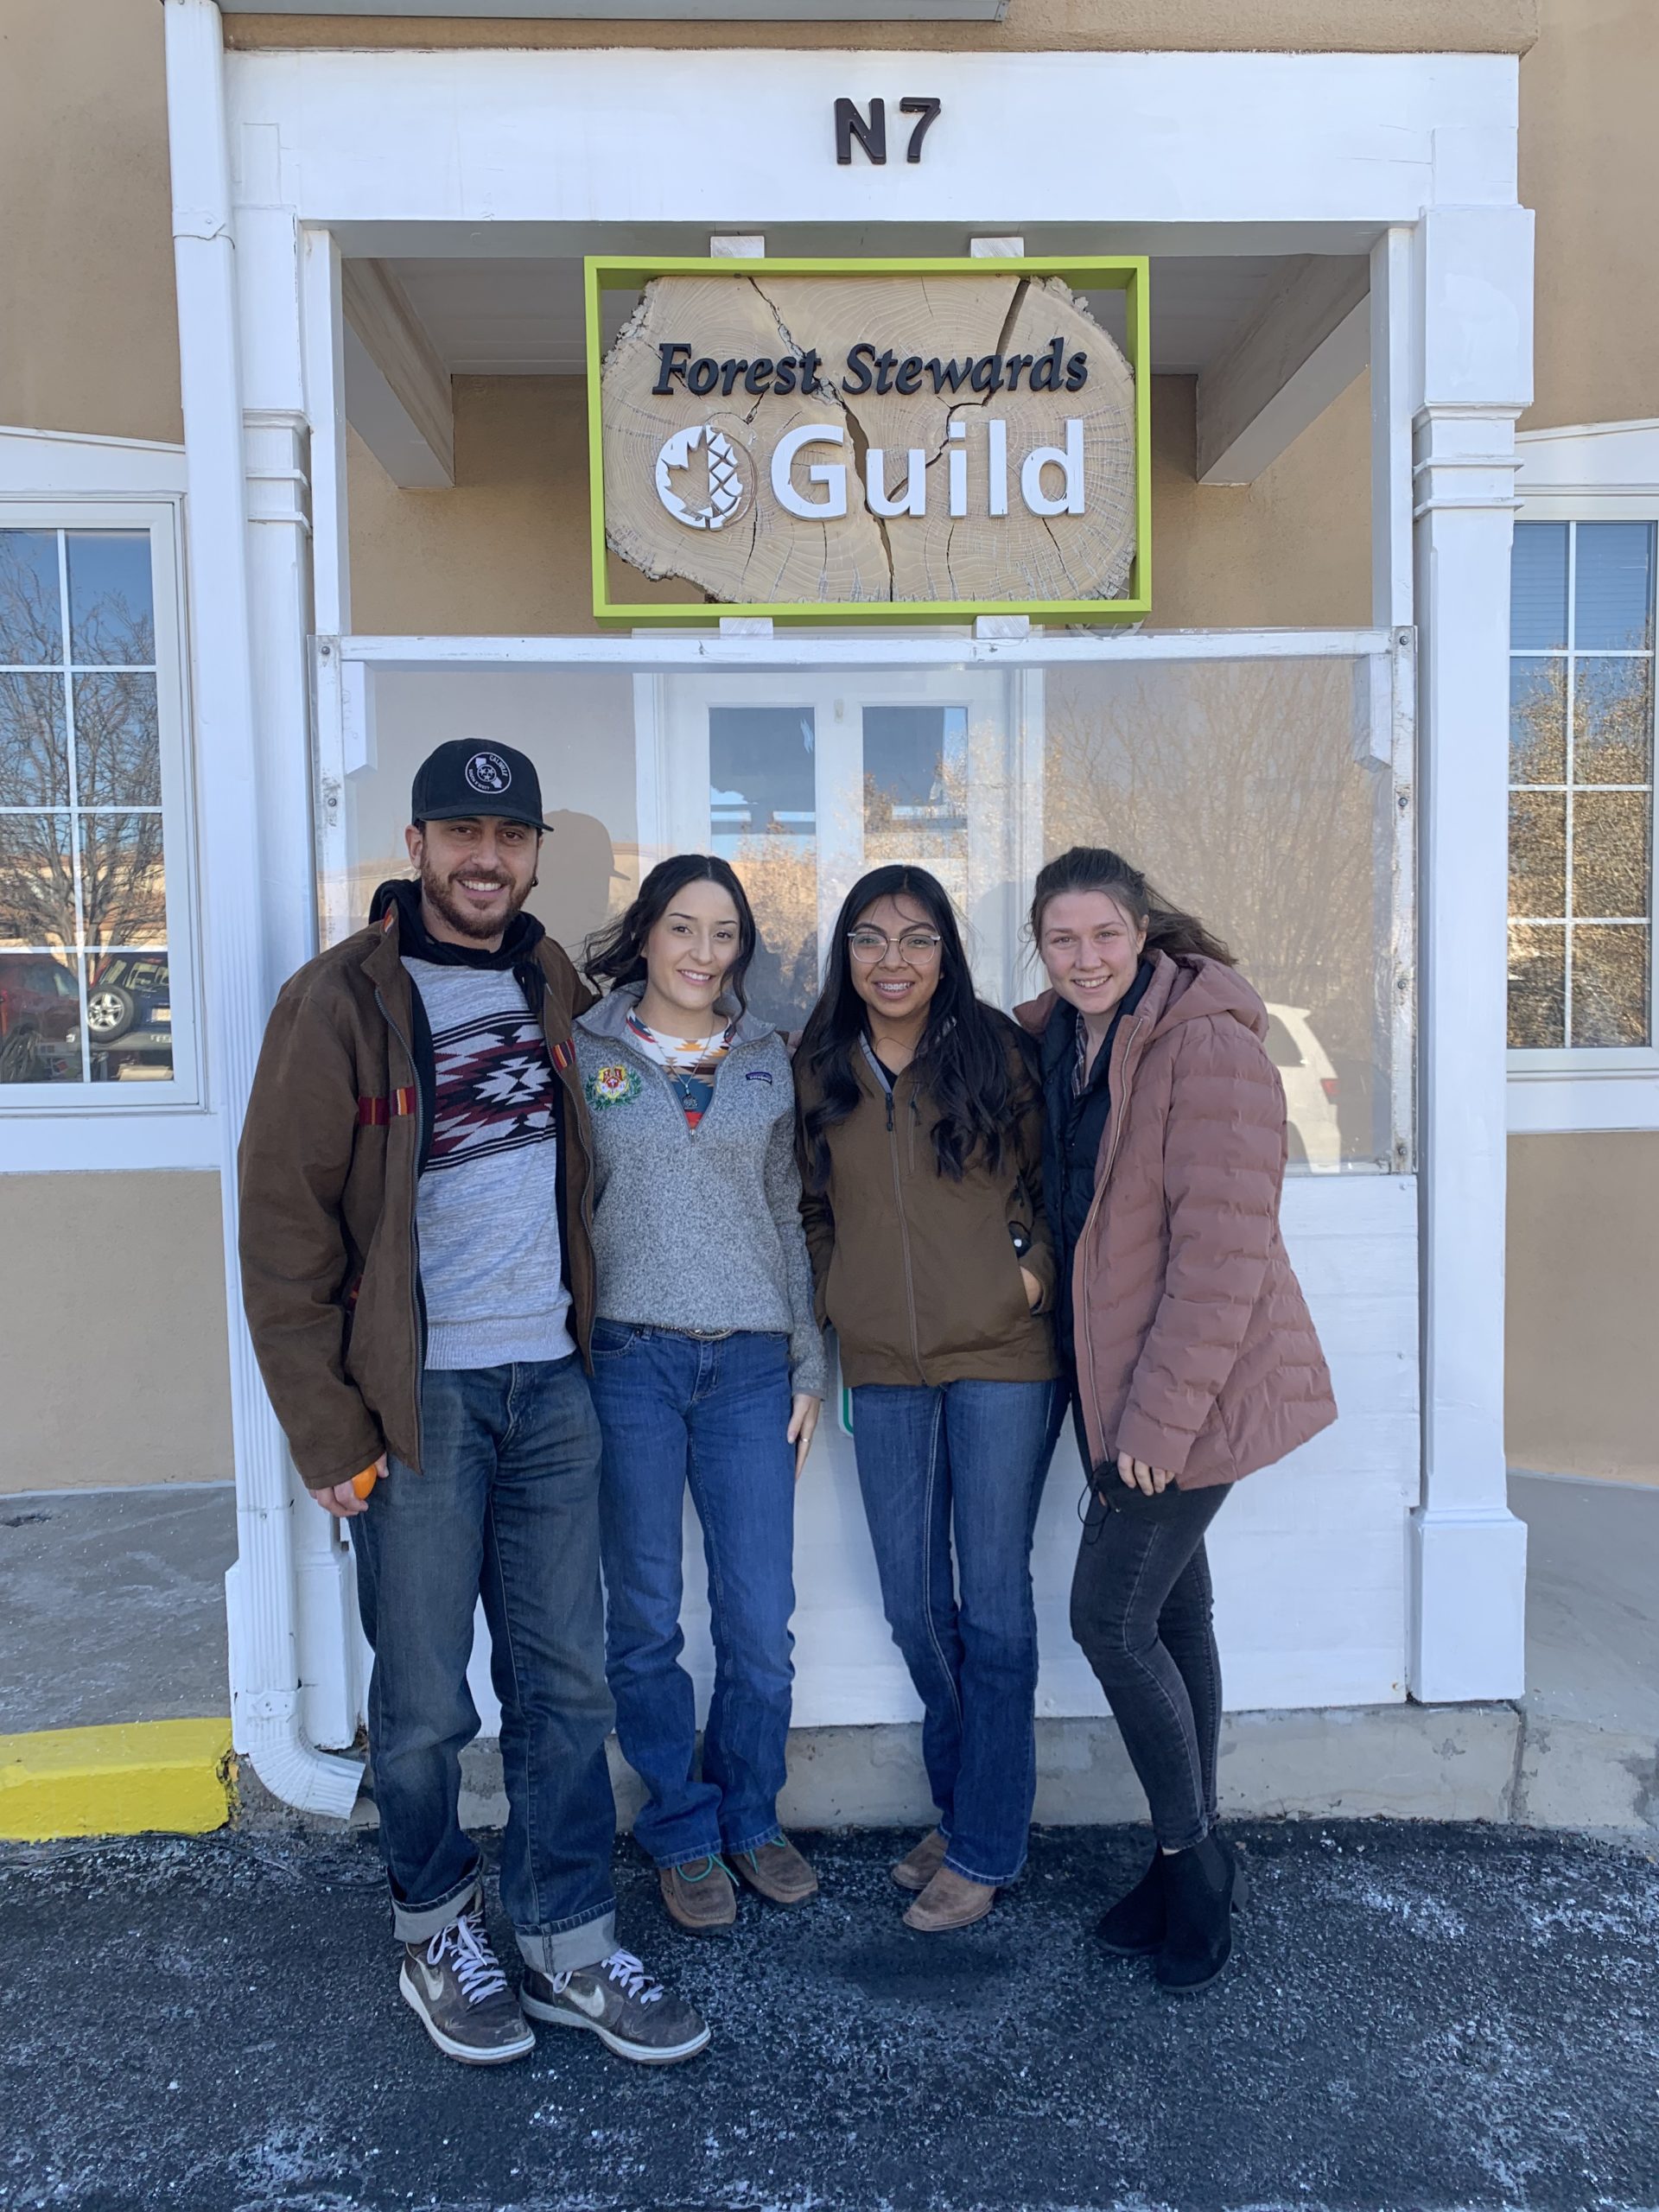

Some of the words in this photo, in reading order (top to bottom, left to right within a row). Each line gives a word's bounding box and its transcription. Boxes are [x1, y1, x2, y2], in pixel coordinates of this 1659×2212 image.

[652, 342, 823, 396] Forest
[842, 337, 1089, 396] Stewards
[771, 419, 1085, 520] Guild
